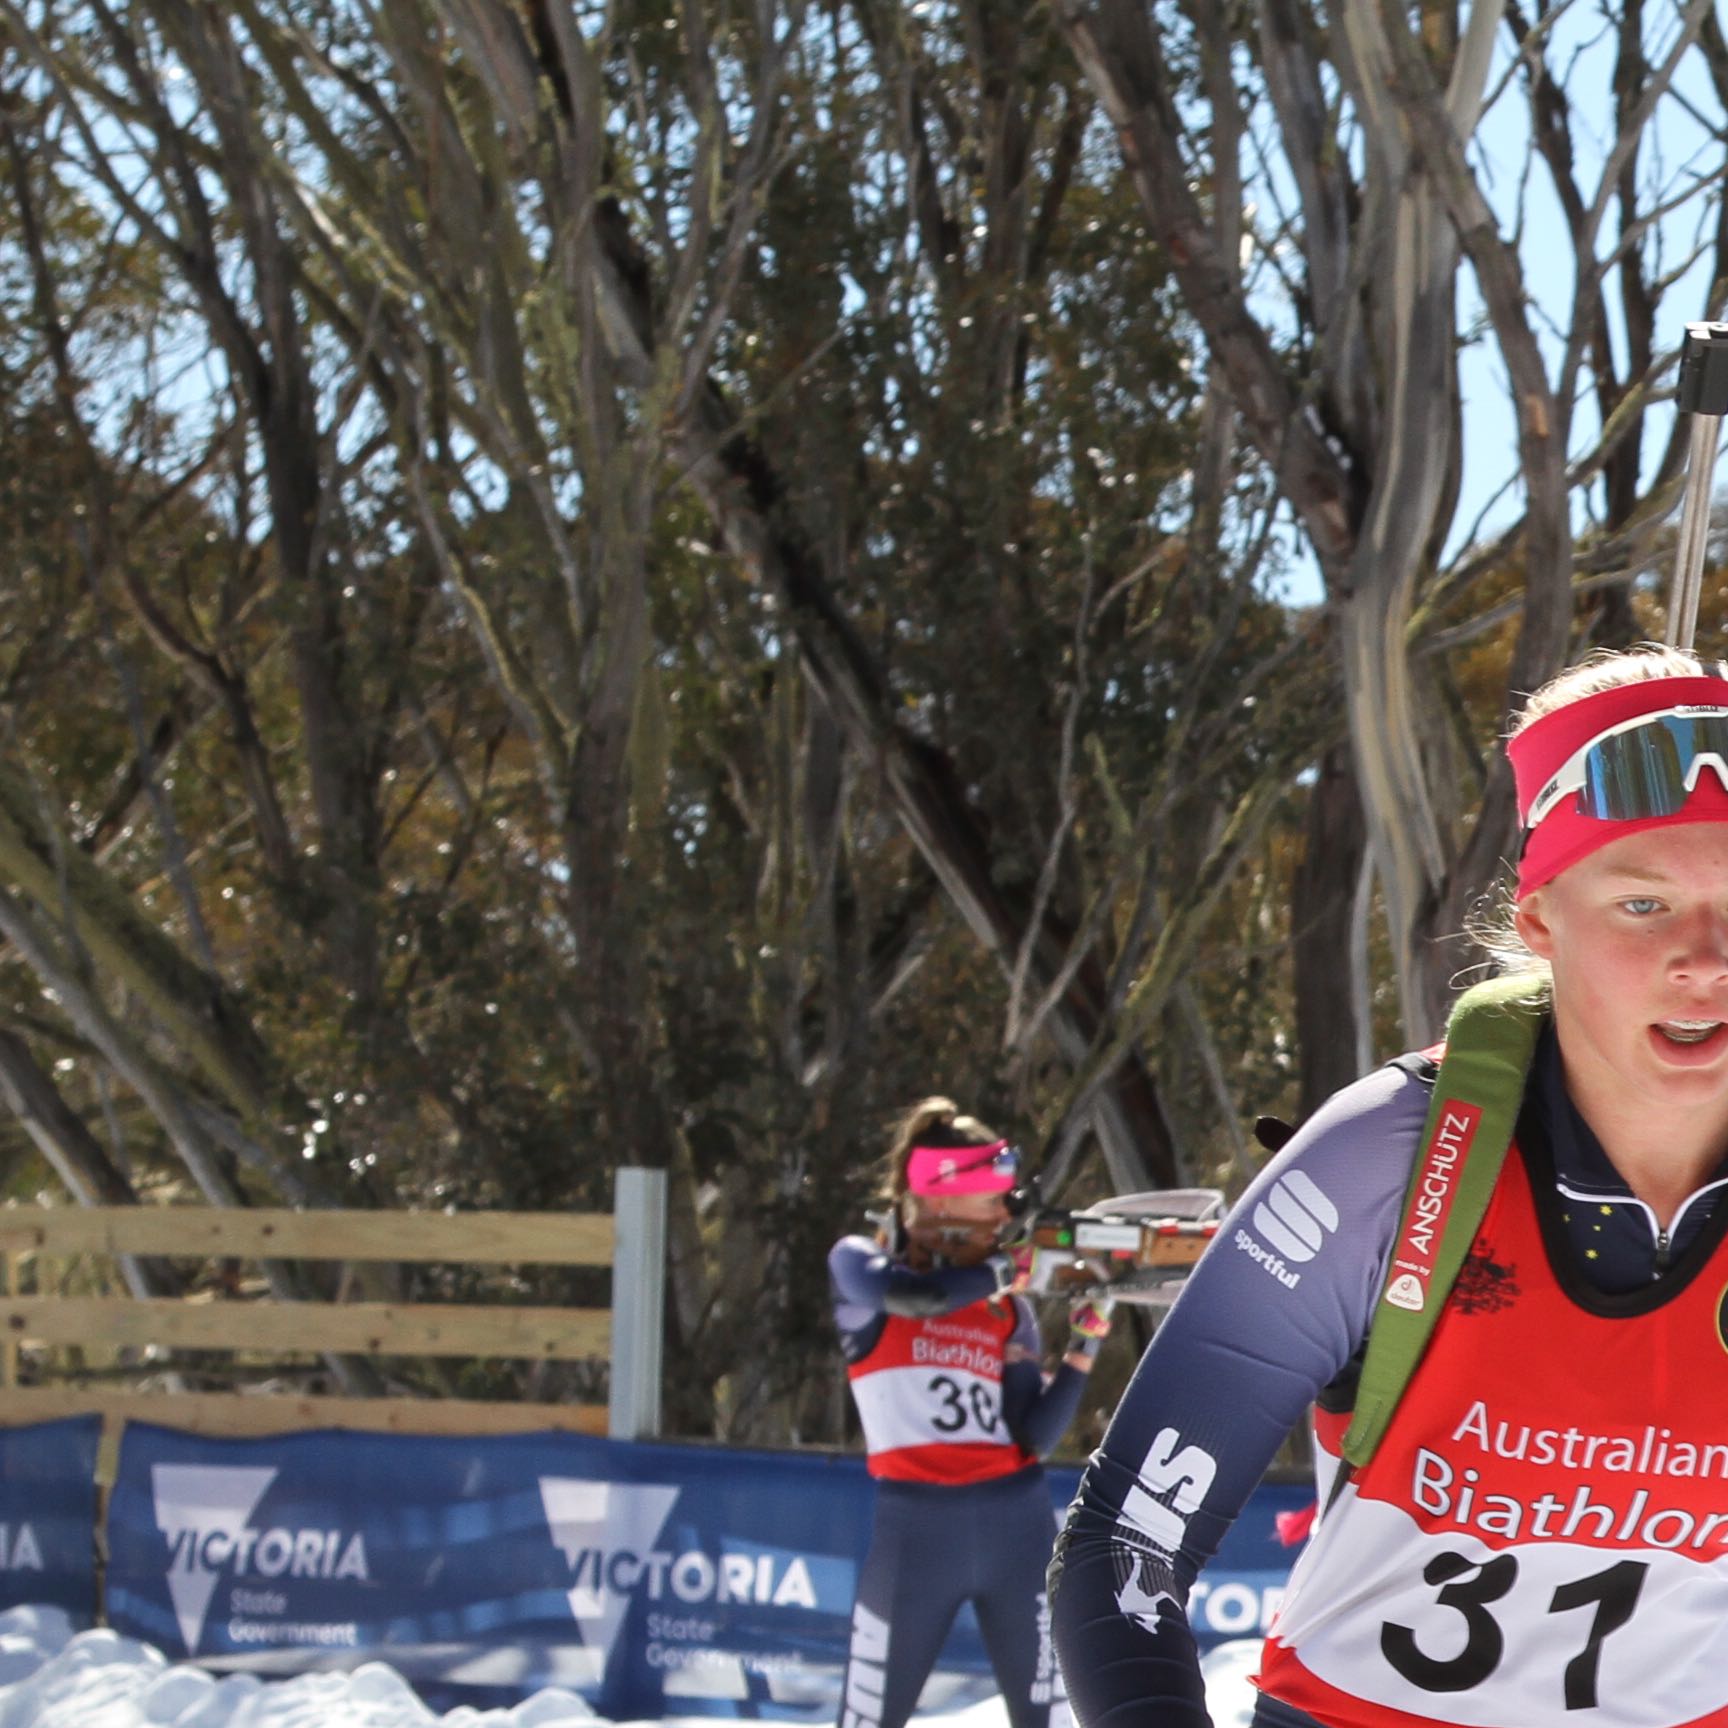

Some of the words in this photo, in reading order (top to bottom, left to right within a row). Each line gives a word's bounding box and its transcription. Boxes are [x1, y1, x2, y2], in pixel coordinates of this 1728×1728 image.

[1233, 1228, 1301, 1289] sportful
[160, 1522, 370, 1581] VICTORIA
[553, 1547, 817, 1608] VICTORIA
[229, 1589, 288, 1614] State
[645, 1613, 716, 1641] State
[1380, 1550, 1651, 1711] 31
